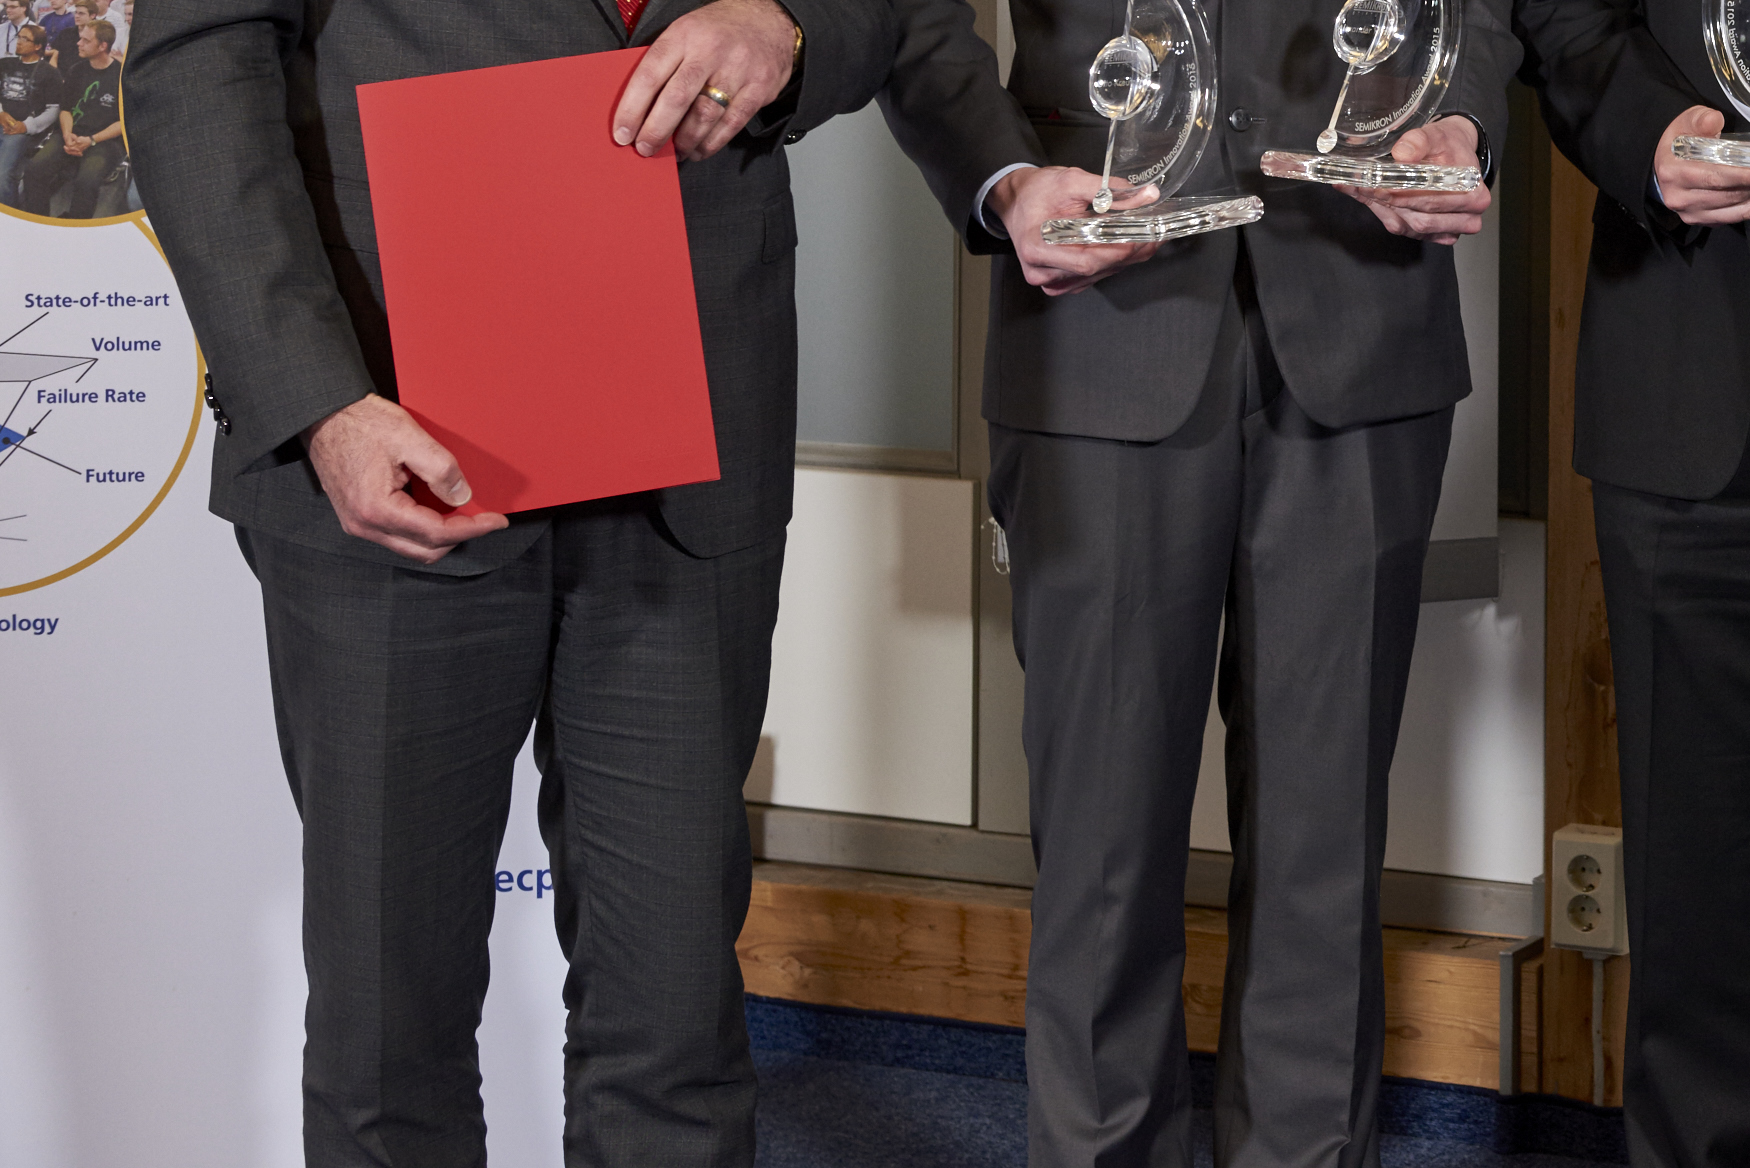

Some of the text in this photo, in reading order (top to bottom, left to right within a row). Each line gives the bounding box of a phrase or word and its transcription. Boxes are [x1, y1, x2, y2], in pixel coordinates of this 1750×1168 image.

[1355, 115, 1392, 132] SEMIKRON
[1393, 83, 1423, 119] Innovation
[1431, 27, 1440, 52] 2015
[1127, 159, 1164, 184] SEMIKRON
[1163, 122, 1189, 164] Innovation
[1189, 62, 1197, 89] 2015
[24, 292, 170, 308] State-of-the-art
[91, 337, 161, 352] Volume
[37, 388, 146, 404] Failure Rate
[85, 469, 145, 483] Future
